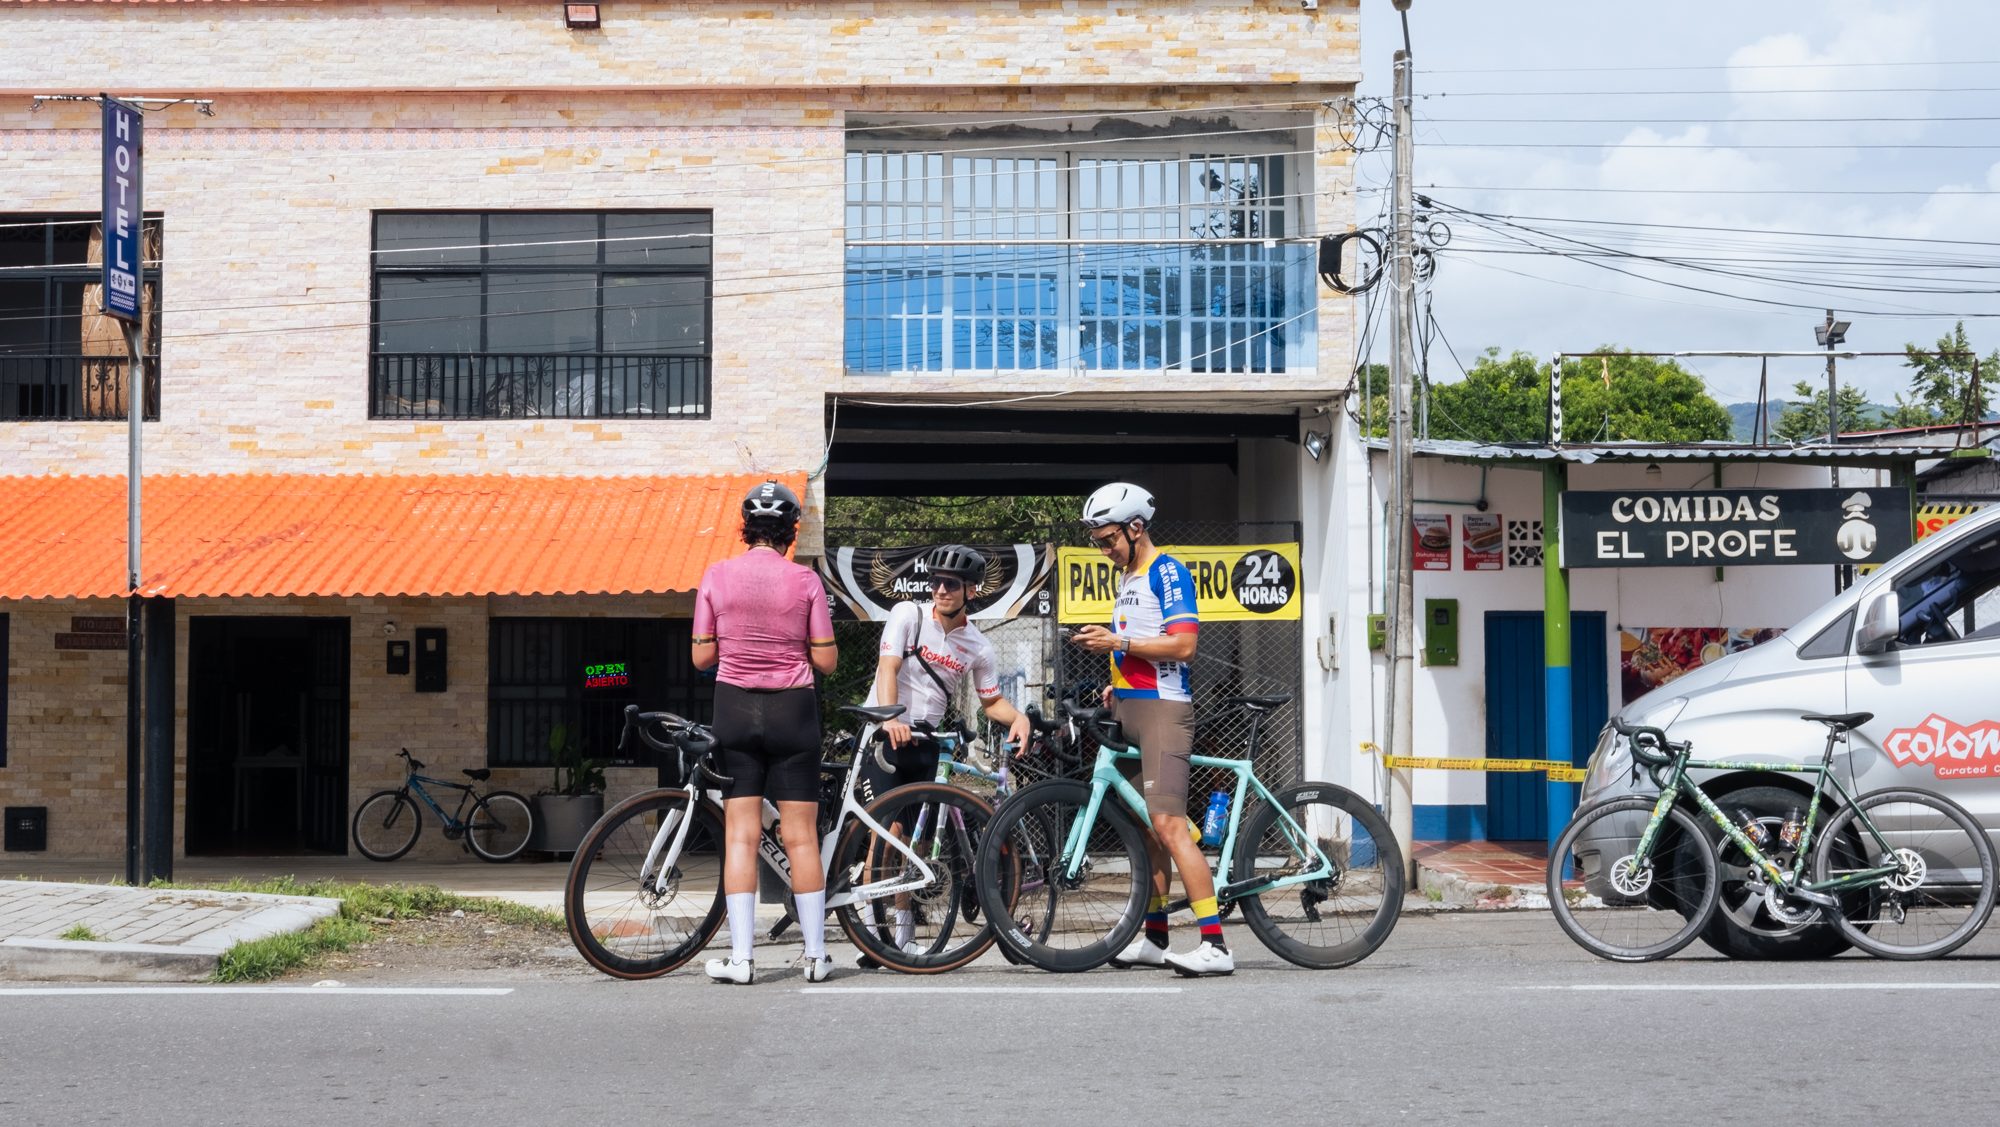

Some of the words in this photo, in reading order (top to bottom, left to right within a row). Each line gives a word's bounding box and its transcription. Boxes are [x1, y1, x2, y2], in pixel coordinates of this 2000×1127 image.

[115, 109, 129, 271] HOTEL
[1611, 495, 1780, 523] COMIDAS
[1596, 530, 1645, 559] EL
[1666, 529, 1798, 559] PROFE
[1245, 554, 1281, 585] 24
[1240, 586, 1287, 605] HORAS
[585, 663, 625, 675] OPEN
[585, 676, 629, 688] ABIERTO
[1938, 765, 1987, 776] Curated
